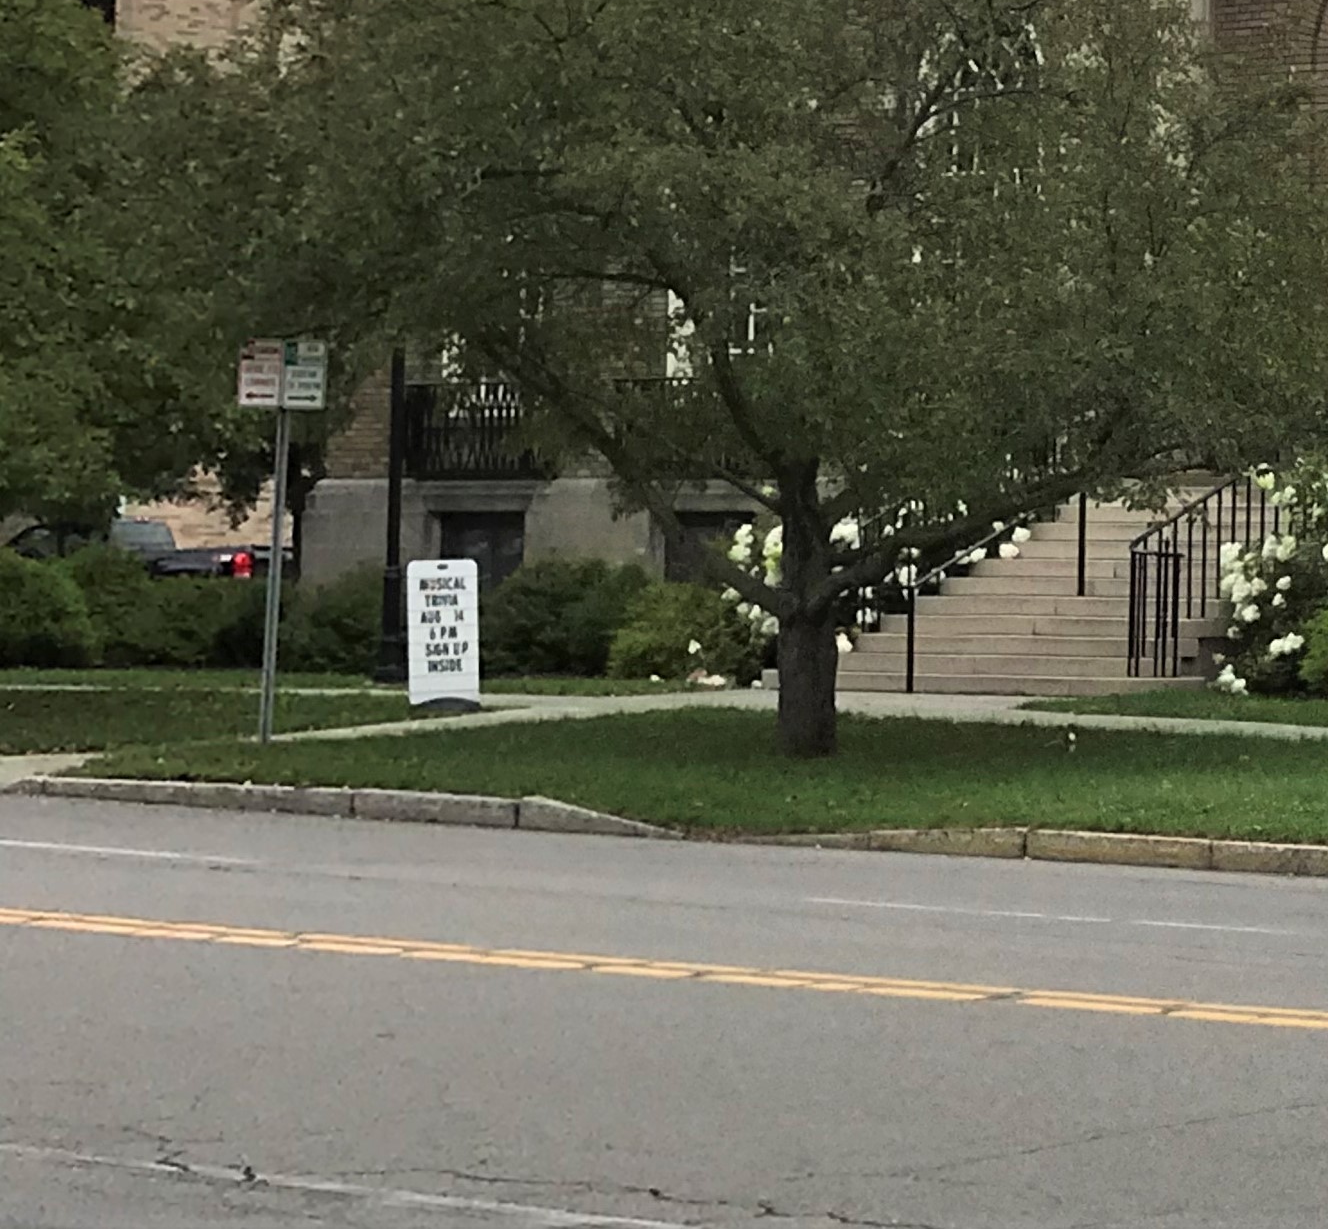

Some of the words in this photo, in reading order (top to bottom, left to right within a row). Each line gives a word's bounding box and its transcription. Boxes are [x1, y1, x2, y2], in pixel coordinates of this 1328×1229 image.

[419, 577, 467, 591] MUSICAL
[424, 594, 459, 607] TRIVIA
[420, 610, 441, 623] AUG
[429, 627, 437, 640] 6
[425, 643, 449, 657] SIGN
[453, 641, 469, 655] UP
[427, 659, 463, 673] INSIDE
